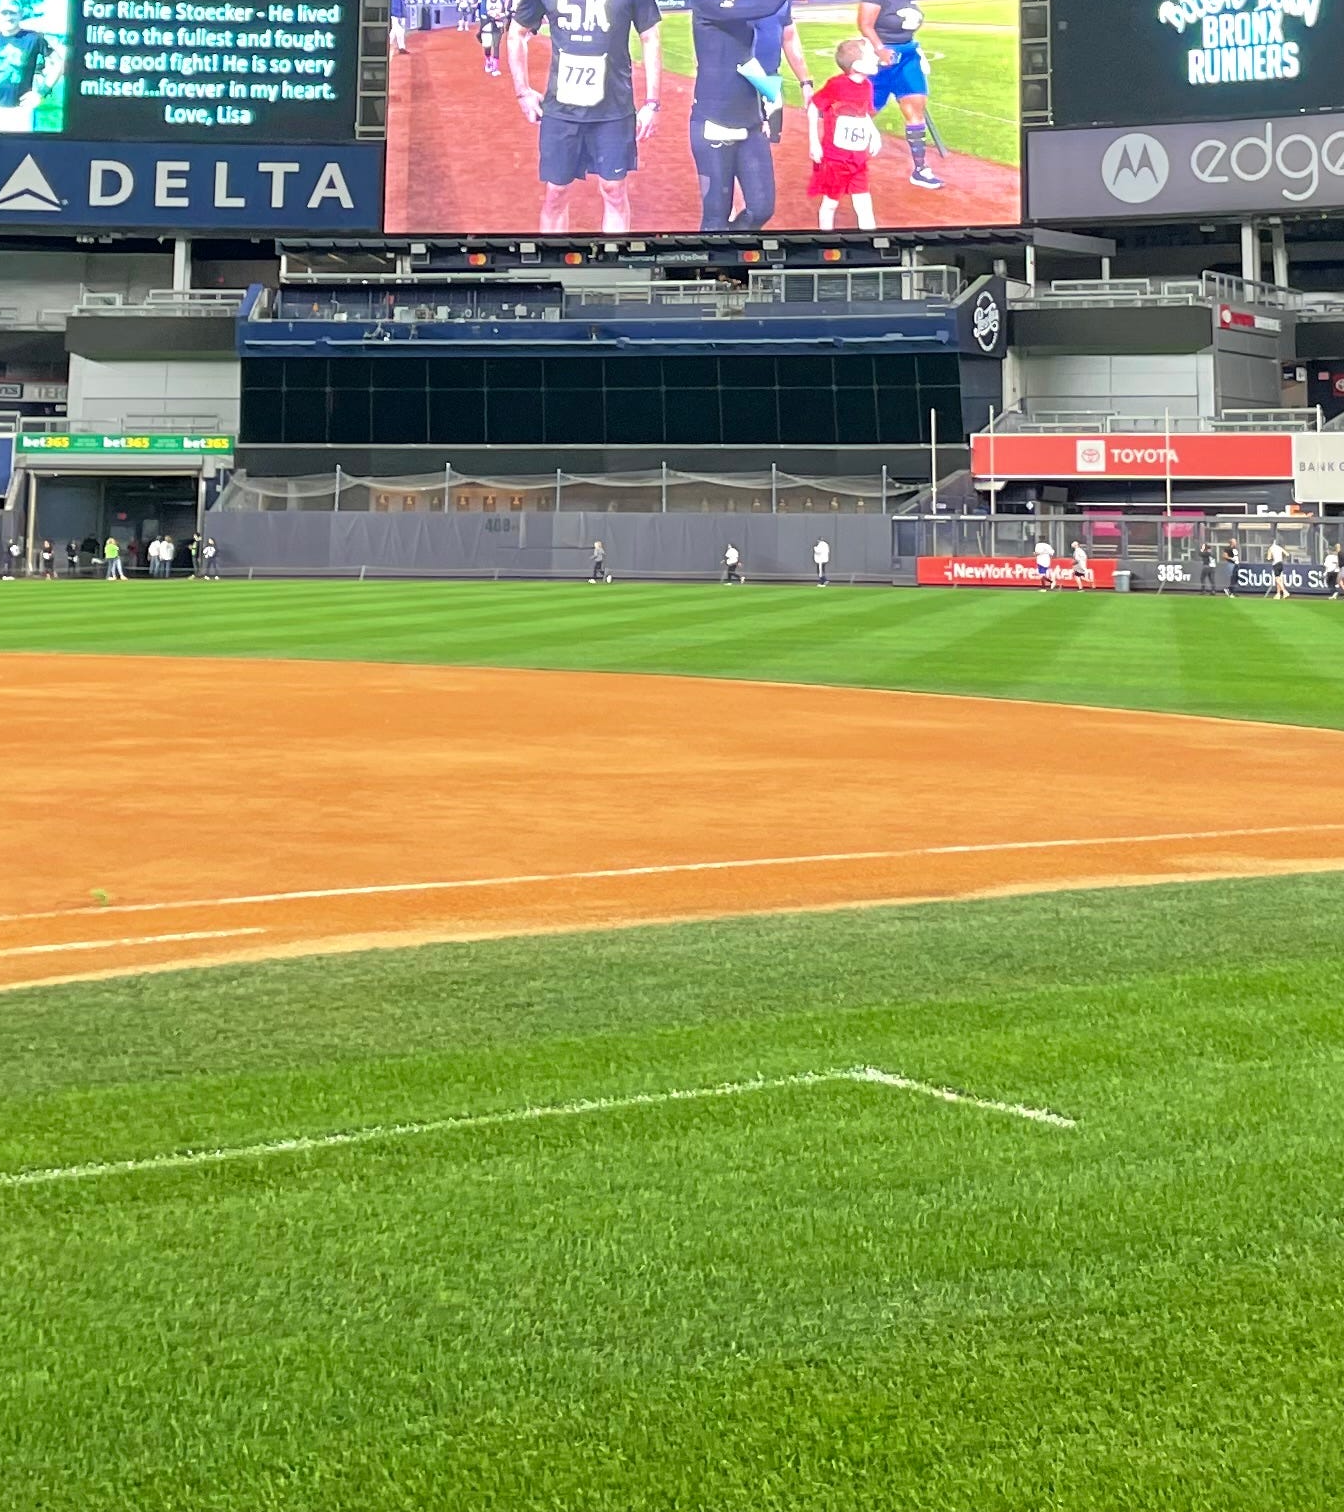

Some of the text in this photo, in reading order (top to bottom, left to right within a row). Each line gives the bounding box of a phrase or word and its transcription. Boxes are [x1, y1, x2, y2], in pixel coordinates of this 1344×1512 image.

[82, 0, 114, 19] For
[117, 0, 172, 21] Richie
[175, 2, 254, 22] Stoecker
[267, 4, 294, 23] He
[297, 4, 341, 24] lived
[86, 24, 336, 52] life to the fullest and fought
[1202, 9, 1284, 49] BRONX
[84, 51, 336, 78] the good fight! He is so very
[1188, 41, 1300, 85] RUNNERS
[565, 65, 597, 86] 772
[229, 80, 248, 99] in
[250, 82, 279, 103] my
[281, 80, 336, 100] heart.
[164, 104, 253, 126] Love, Lisa
[88, 159, 355, 210] DELTA
[22, 435, 69, 448] bet365
[103, 436, 150, 449] bet365
[183, 437, 229, 449] bet365
[1111, 448, 1179, 464] TOYOTA
[1299, 462, 1335, 473] BANK
[953, 563, 1094, 581] NewYork-Presytern
[1157, 564, 1183, 582] 385
